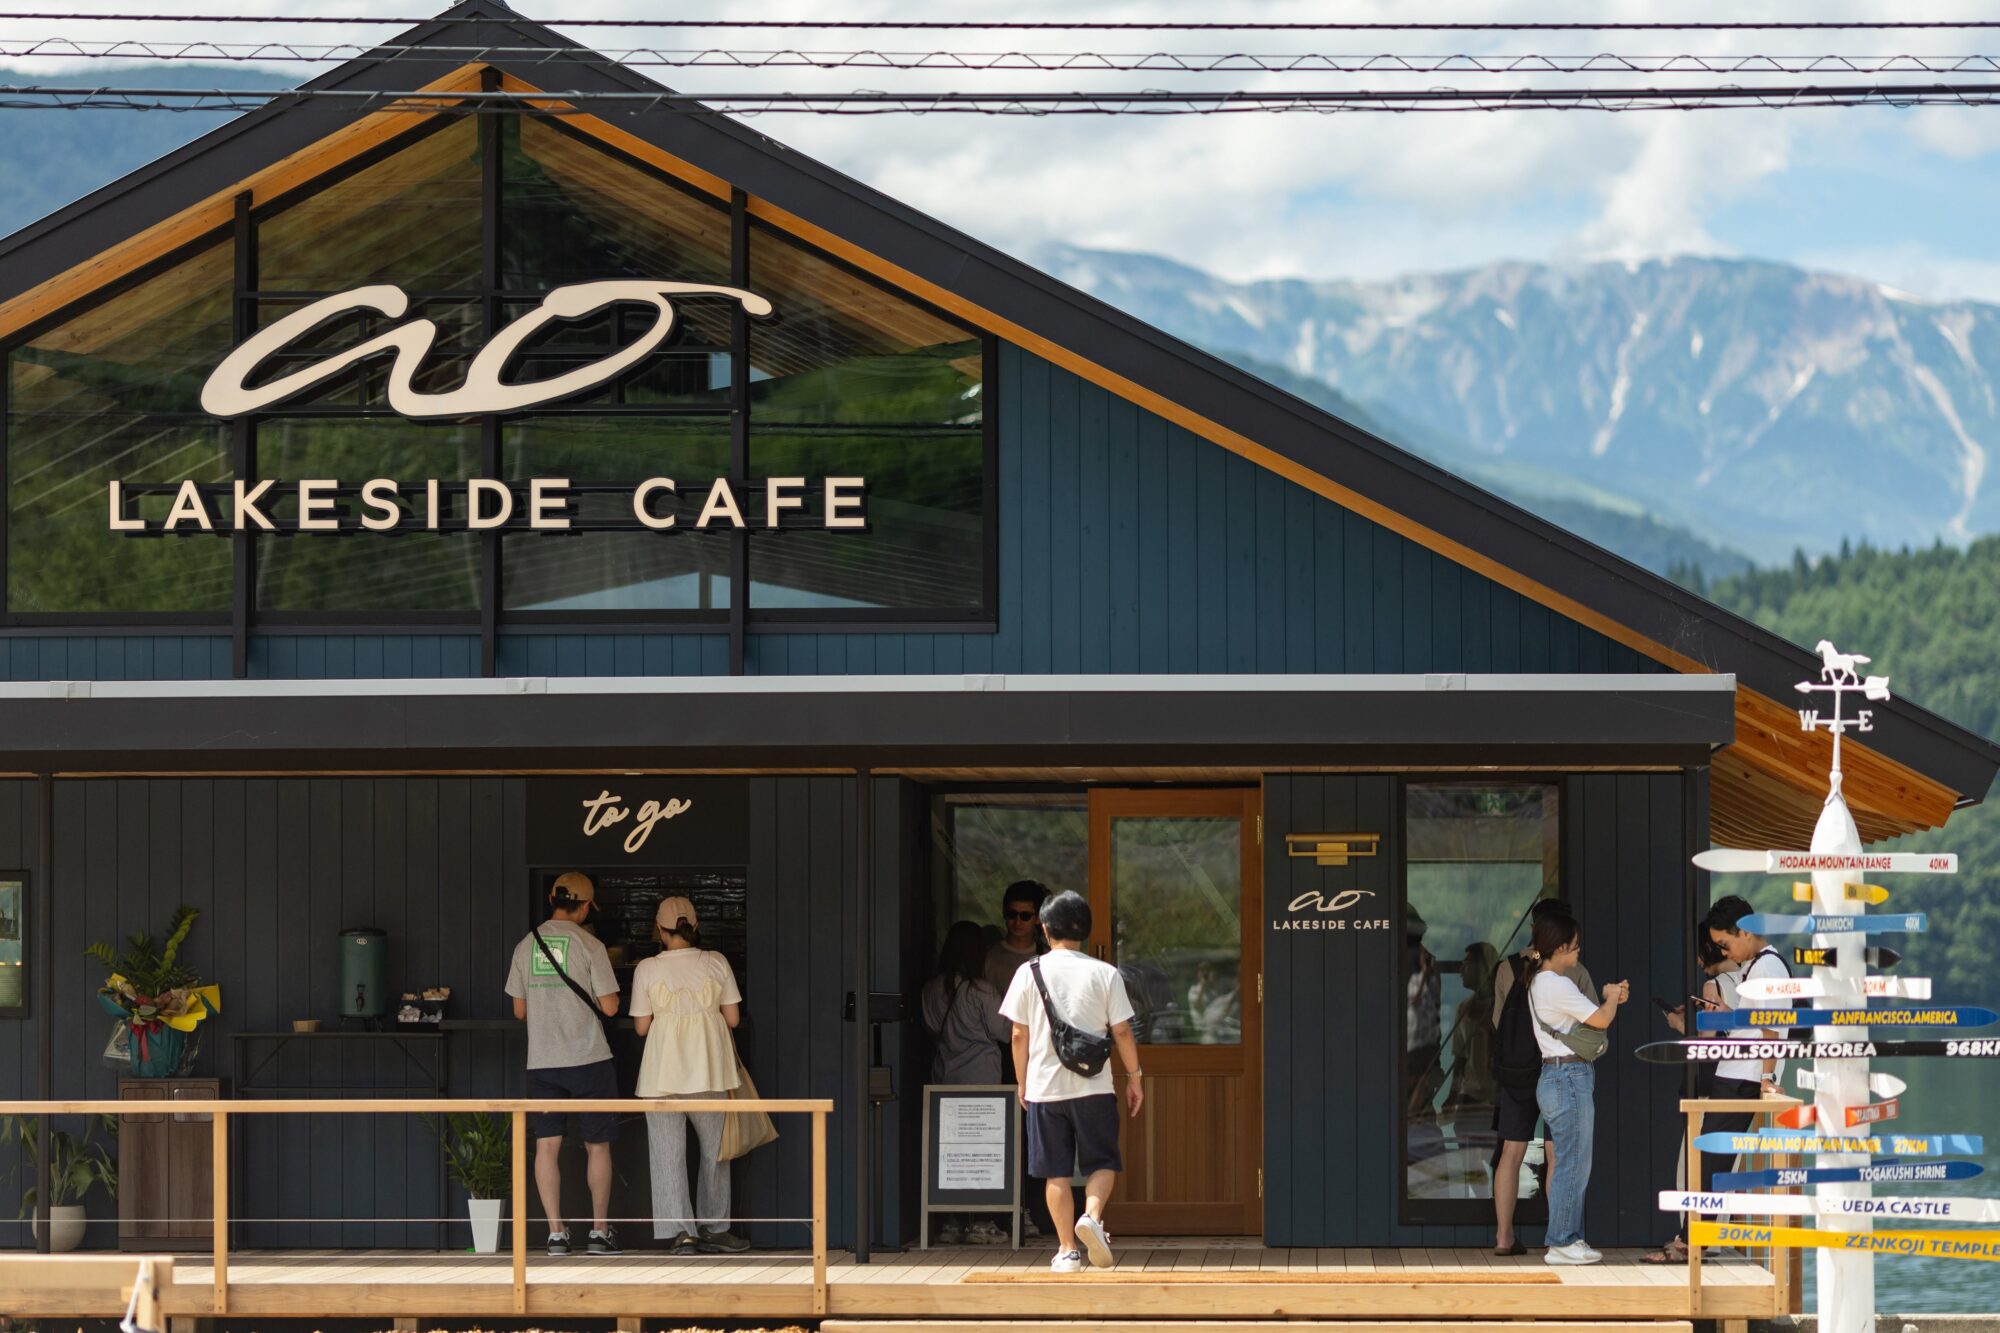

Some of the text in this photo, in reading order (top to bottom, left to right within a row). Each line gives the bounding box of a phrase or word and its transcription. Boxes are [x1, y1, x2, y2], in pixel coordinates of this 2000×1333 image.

[108, 476, 866, 532] LAKESIDE CAFE
[1799, 711, 1818, 731] W
[1859, 711, 1873, 731] E
[582, 790, 692, 853] to go
[1779, 856, 1949, 870] HODAKA MOUNTAIN RANGE 40KM
[1273, 920, 1390, 930] LAKESIDE CAFE
[1750, 1011, 1797, 1025] 8337KM
[1815, 1042, 1877, 1058] KOREA
[1777, 1165, 1947, 1184] 25KM TOGAKUSHI SHRINE
[1681, 1198, 1951, 1215] 41KM UEDA CASTLE
[1717, 1227, 2000, 1256] 30KM ZENKOJI TEMPLE
